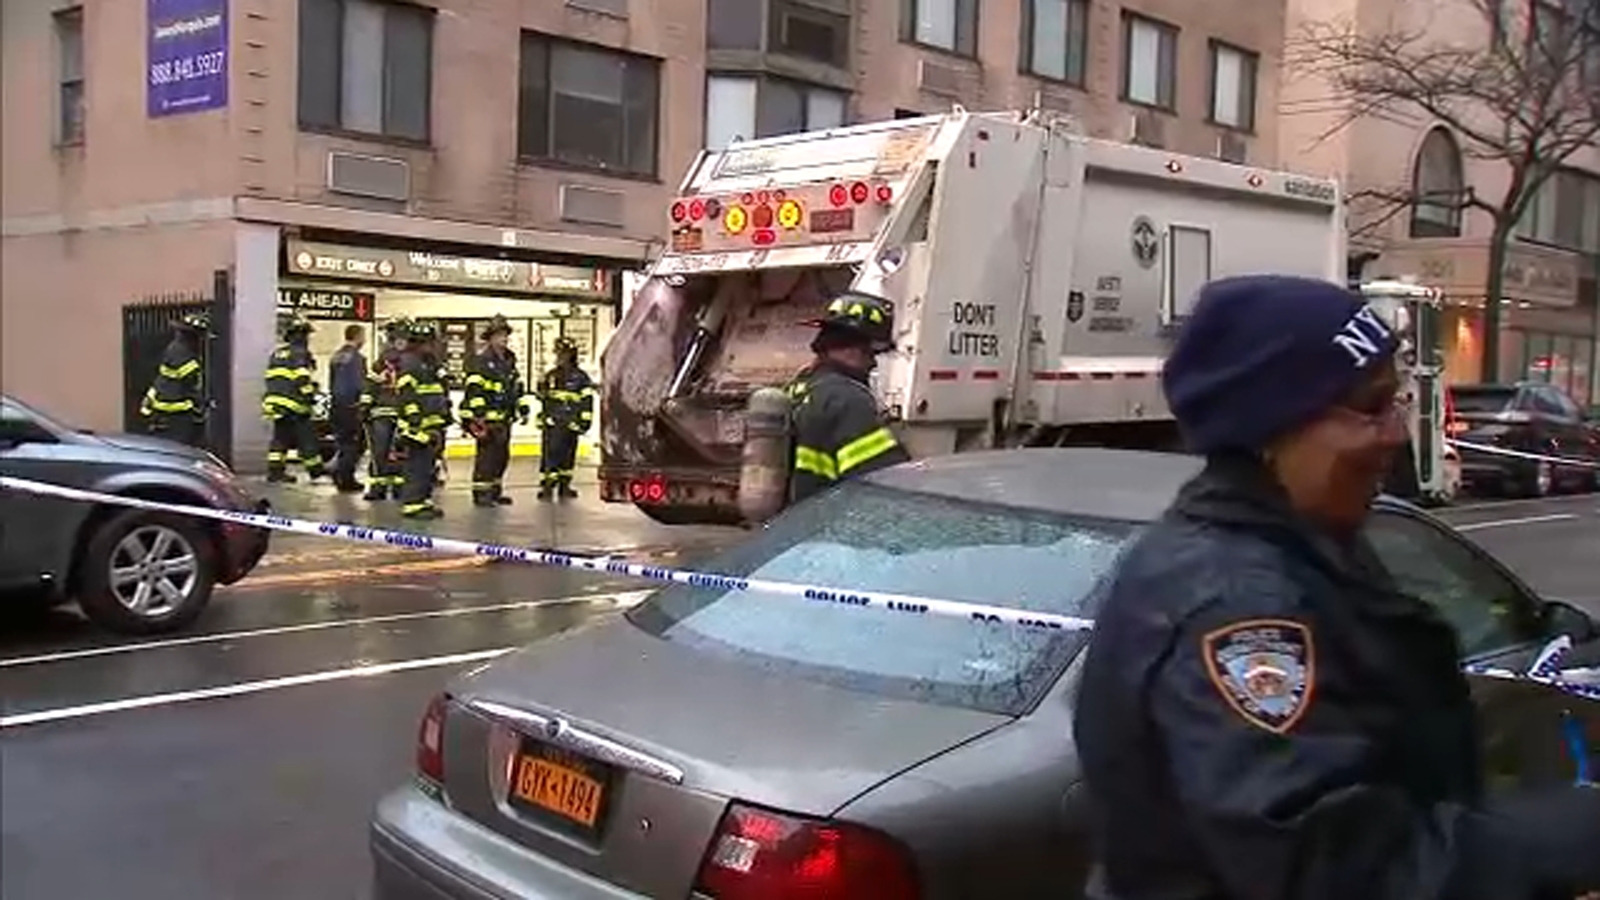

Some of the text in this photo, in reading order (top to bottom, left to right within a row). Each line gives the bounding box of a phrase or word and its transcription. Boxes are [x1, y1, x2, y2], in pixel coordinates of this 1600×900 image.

[298, 292, 354, 309] AHEAD
[949, 331, 999, 358] LITTER
[804, 588, 871, 607] POLICE
